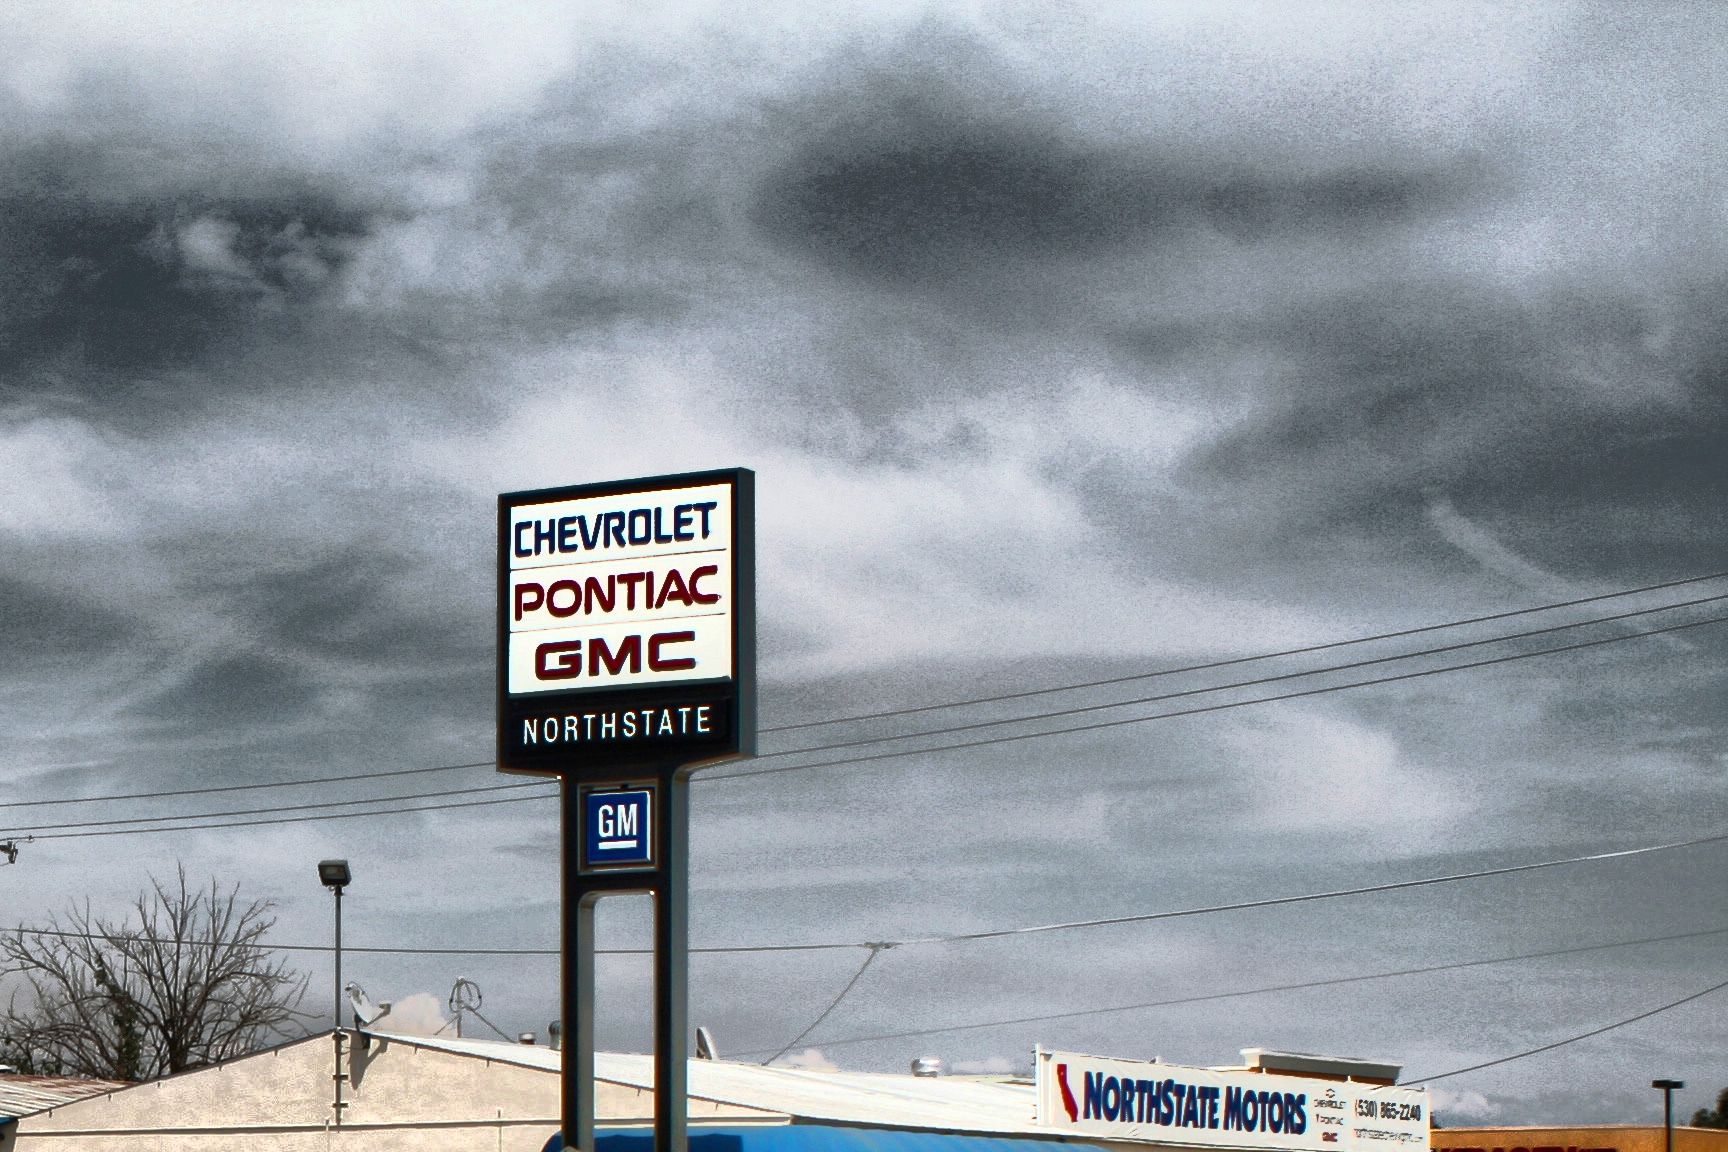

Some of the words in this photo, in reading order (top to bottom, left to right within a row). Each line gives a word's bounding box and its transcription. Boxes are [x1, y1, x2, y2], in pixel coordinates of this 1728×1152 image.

[514, 502, 718, 558] CHEVROLET
[514, 565, 721, 621] PONTIAC
[535, 631, 696, 681] GMC
[523, 706, 711, 745] NORTHSTATE
[598, 804, 638, 838] GM
[1223, 1085, 1307, 1136] MOTORS
[1355, 1099, 1378, 1120] (530)
[1380, 1101, 1422, 1122] 865-2240
